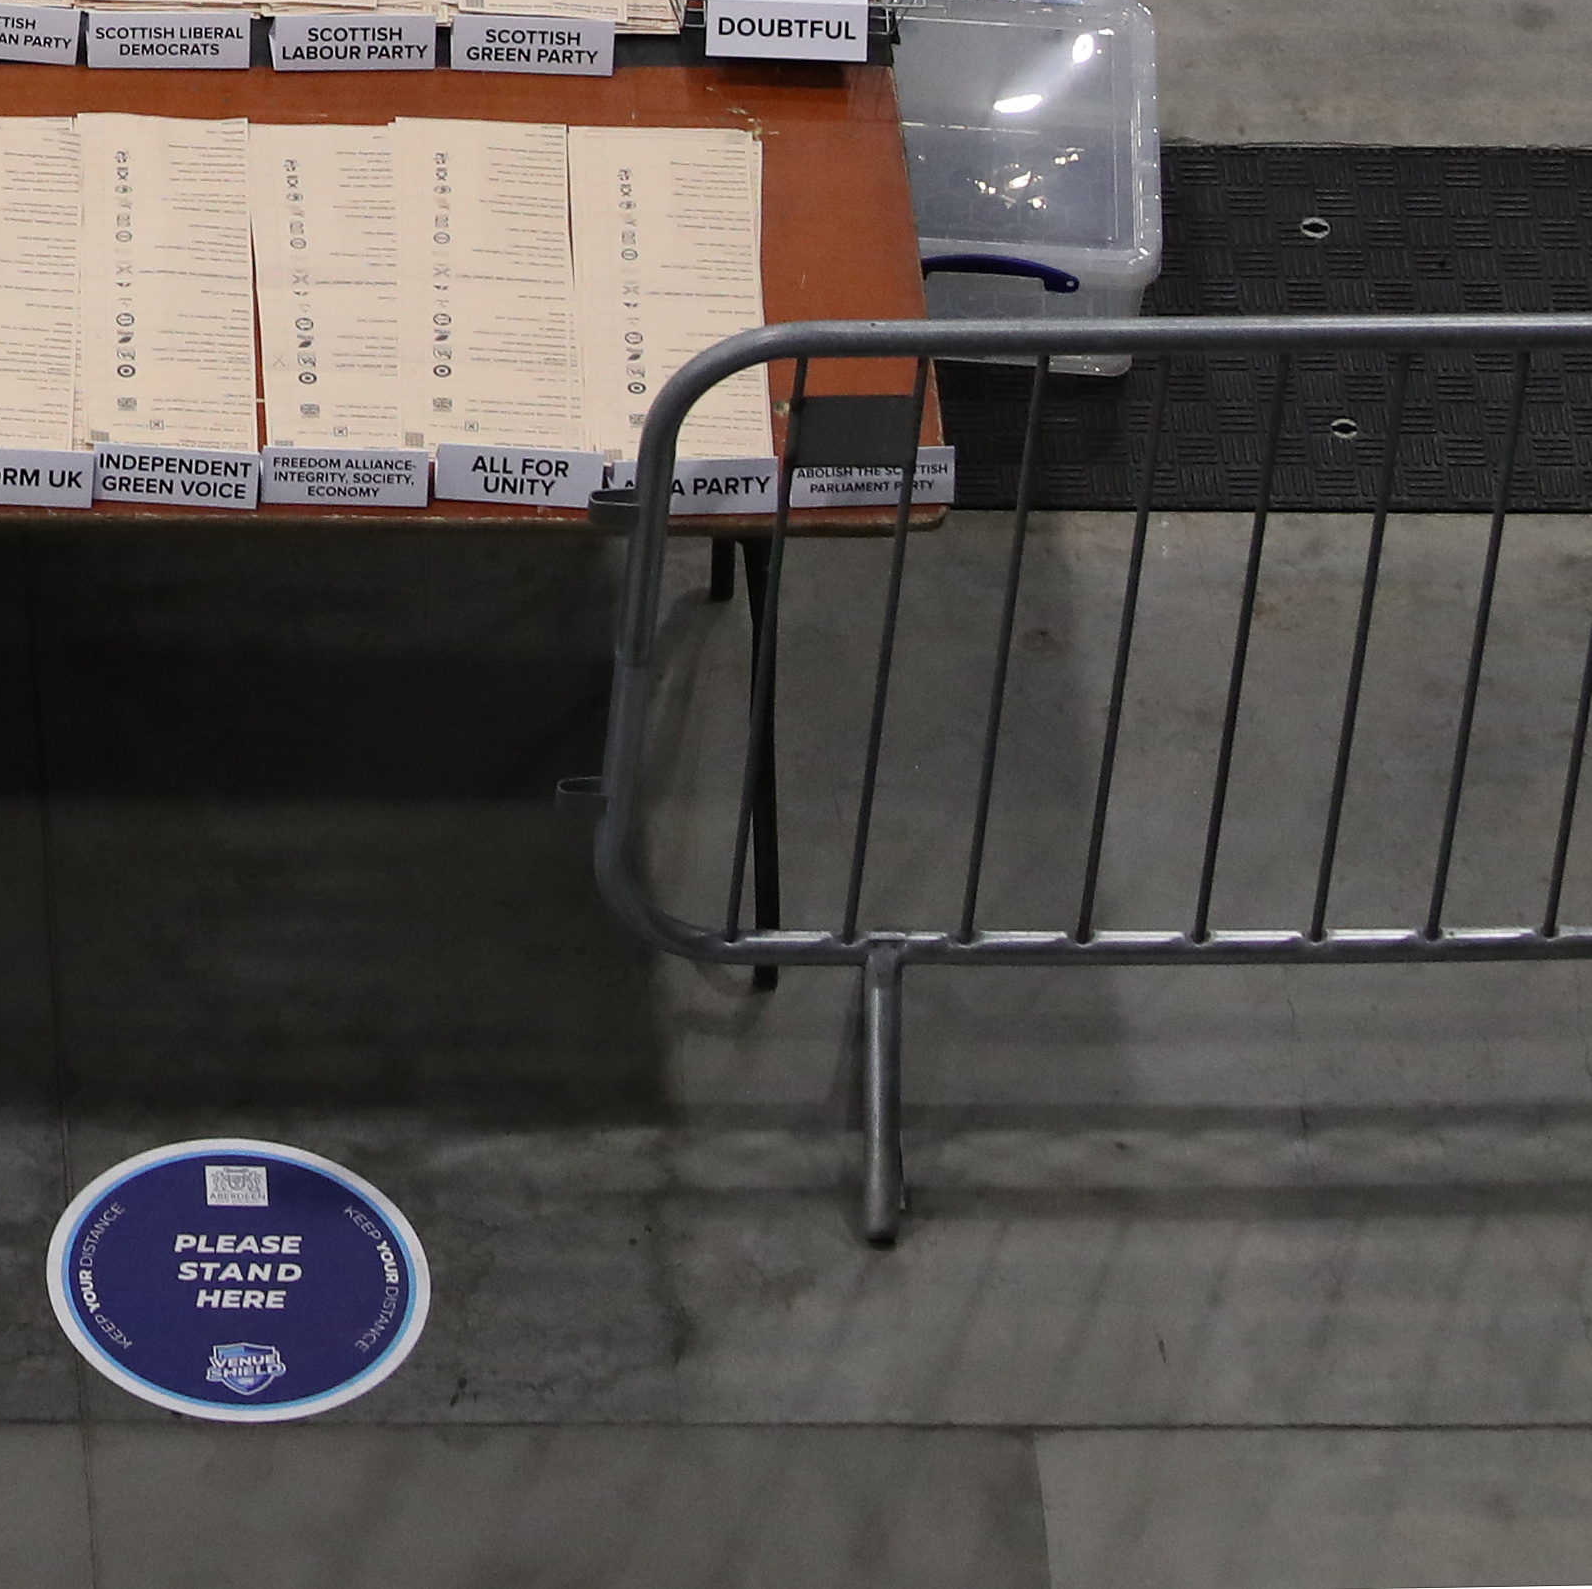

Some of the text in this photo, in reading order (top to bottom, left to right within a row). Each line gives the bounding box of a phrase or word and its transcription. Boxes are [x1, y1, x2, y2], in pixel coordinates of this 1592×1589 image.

[95, 27, 244, 39] SCOTTISH LIBERAL
[307, 27, 402, 41] SCOTTISH
[718, 17, 857, 40] DOUBTFUL
[23, 35, 72, 50] PARTY
[485, 29, 581, 46] SCOTTISH
[119, 43, 220, 56] DEMOCRATS
[282, 44, 428, 60] LABOUR PARTY
[466, 47, 599, 64] GREEN PARTY
[99, 453, 252, 478] INDEPENDENT
[273, 457, 341, 469] FREEDOM
[471, 455, 569, 478] ALL FOR
[797, 467, 852, 479] ABOLISH
[884, 463, 948, 476] SCTISH
[48, 470, 83, 489] UK
[274, 471, 415, 486] INTEGRITY, SOCIETY,
[483, 477, 556, 497] UNITY
[693, 476, 771, 495] PARTY
[810, 480, 935, 493] PARLIAMENT PRTY
[102, 475, 246, 500] GREEN VOICE
[307, 485, 380, 498] ECONOMY
[174, 1235, 302, 1254] PLEASE
[79, 1202, 132, 1350] KEEP YOUR DISTANCE
[177, 1263, 302, 1282] STAND
[344, 1205, 400, 1353] KEEP YOUR DISTANCE
[196, 1290, 286, 1309] HERE
[214, 1354, 276, 1368] VENUE
[209, 1364, 283, 1381] SHIELD
